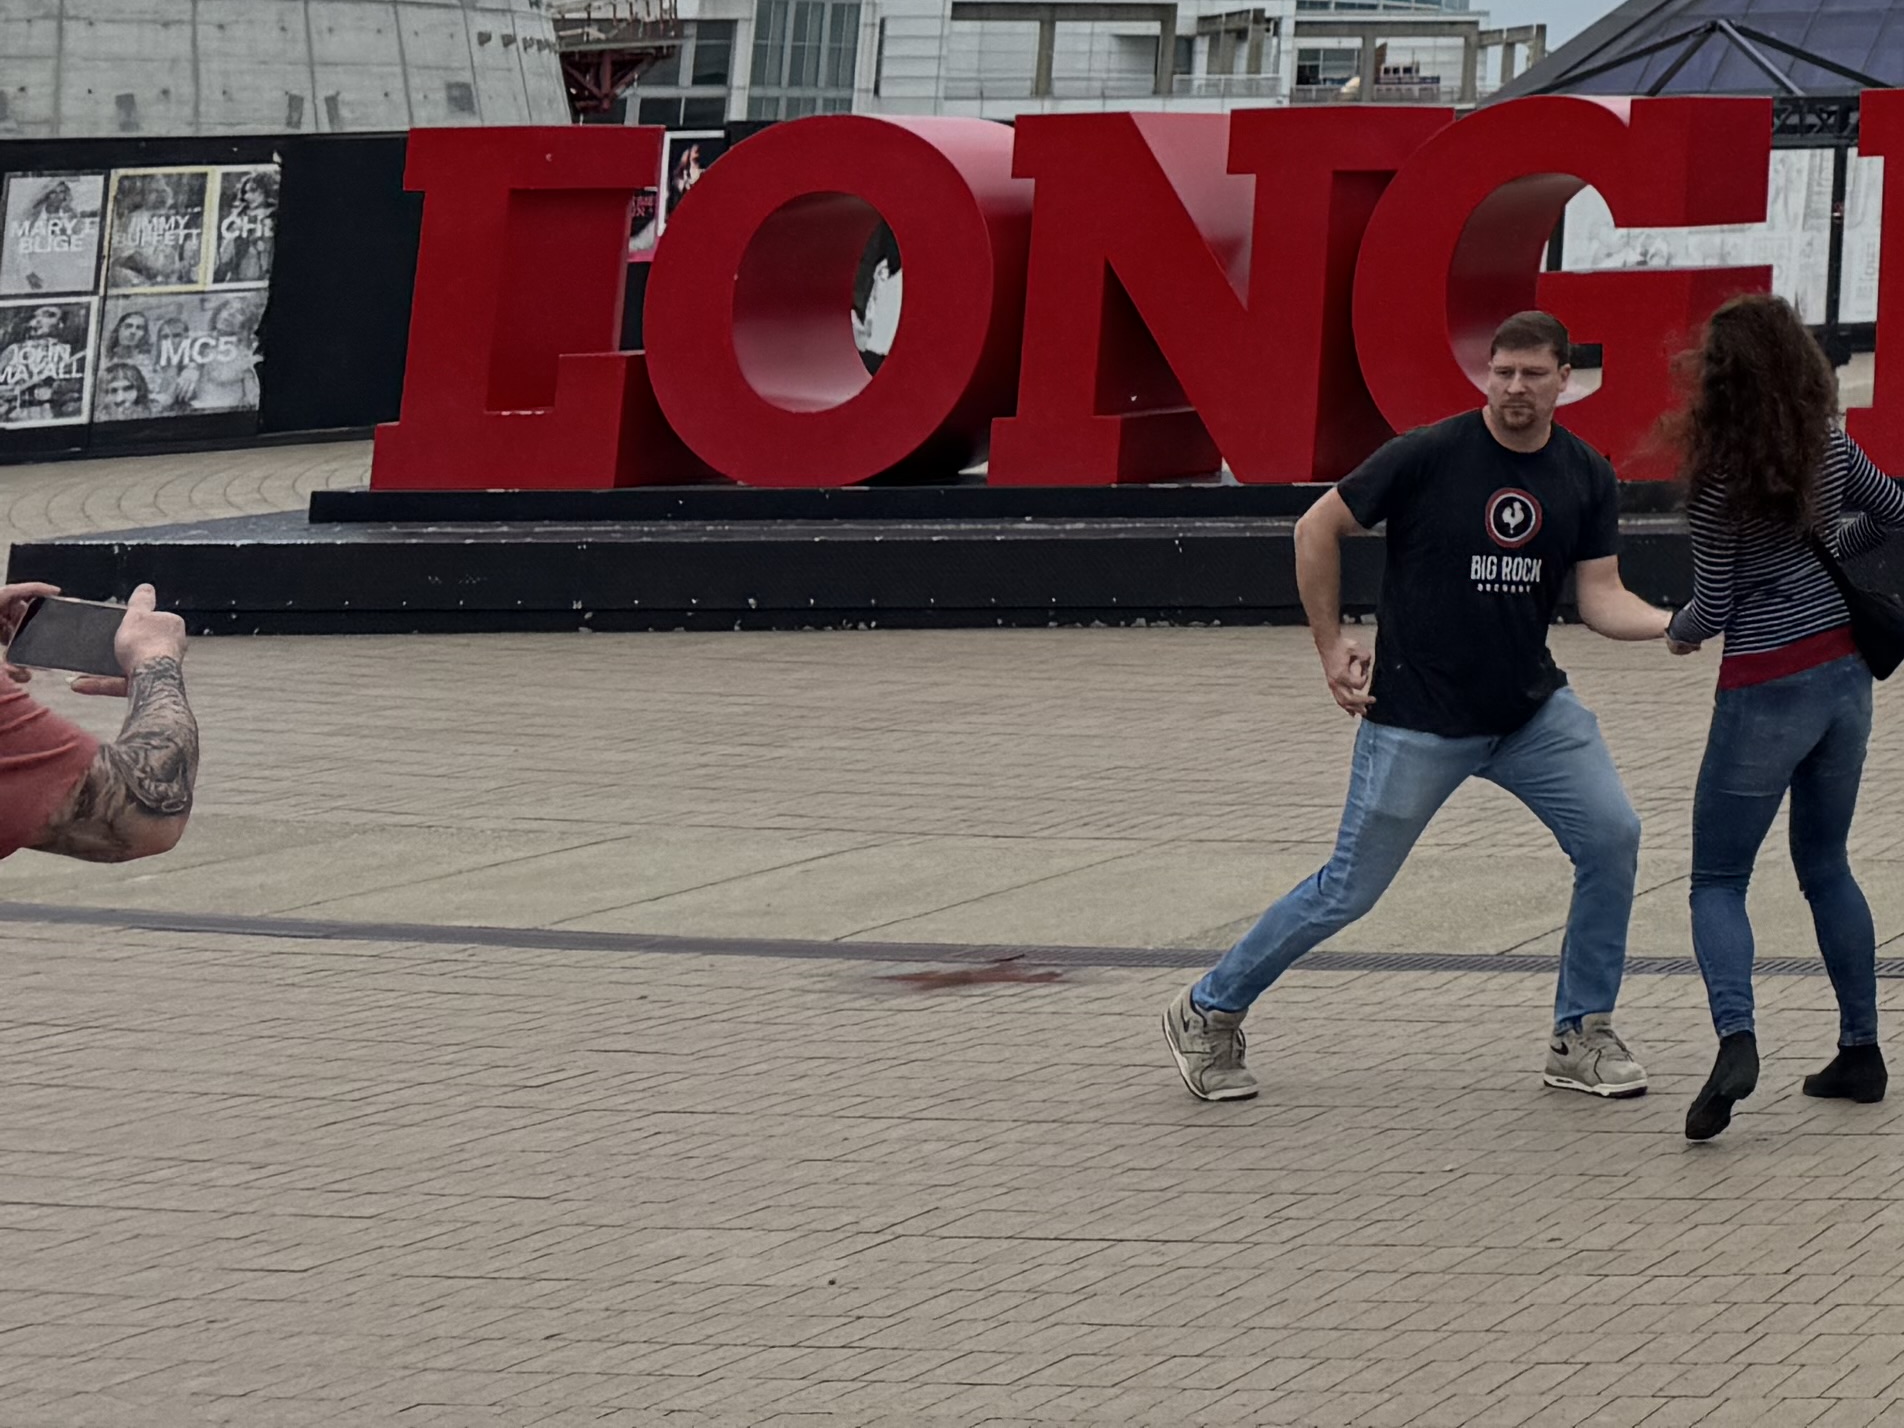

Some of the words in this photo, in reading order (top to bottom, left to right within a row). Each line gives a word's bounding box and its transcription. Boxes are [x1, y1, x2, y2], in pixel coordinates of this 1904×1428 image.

[372, 94, 1773, 488] LONG
[158, 336, 239, 367] MC5
[1470, 555, 1498, 581] BIG
[1501, 556, 1542, 583] ROCK
